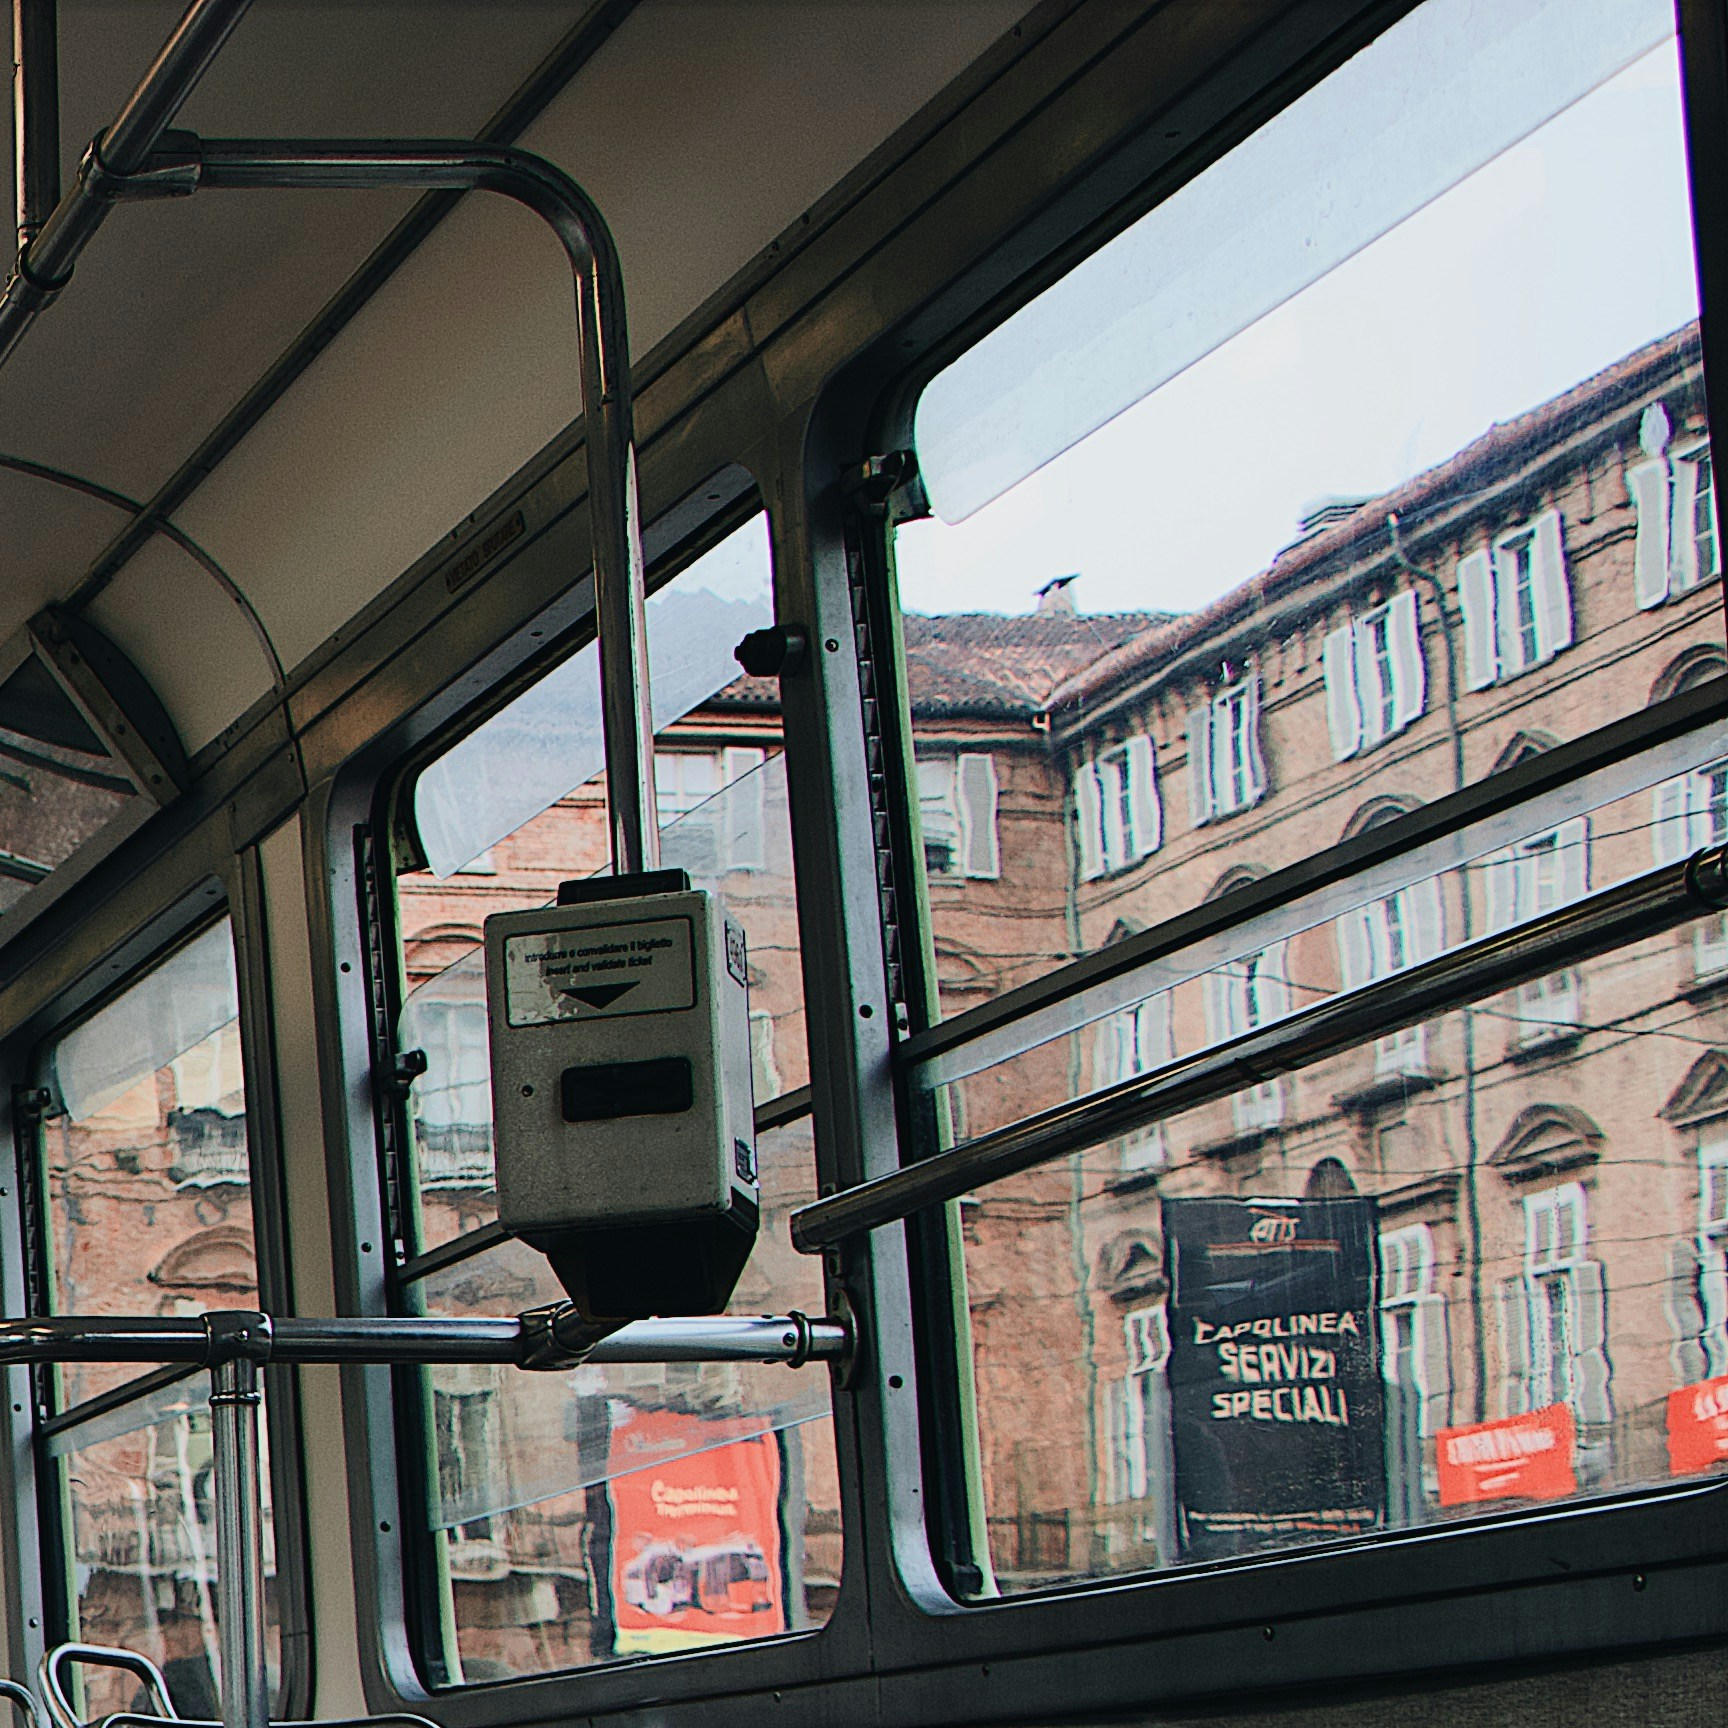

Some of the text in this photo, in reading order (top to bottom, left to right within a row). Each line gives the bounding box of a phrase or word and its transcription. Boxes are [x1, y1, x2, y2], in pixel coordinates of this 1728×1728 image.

[636, 937, 673, 952] biglietto
[572, 961, 590, 973] and
[1192, 1310, 1361, 1345] CAPOLINEA
[1217, 1341, 1338, 1384] SERVIZI
[1210, 1384, 1350, 1427] SPECIALI
